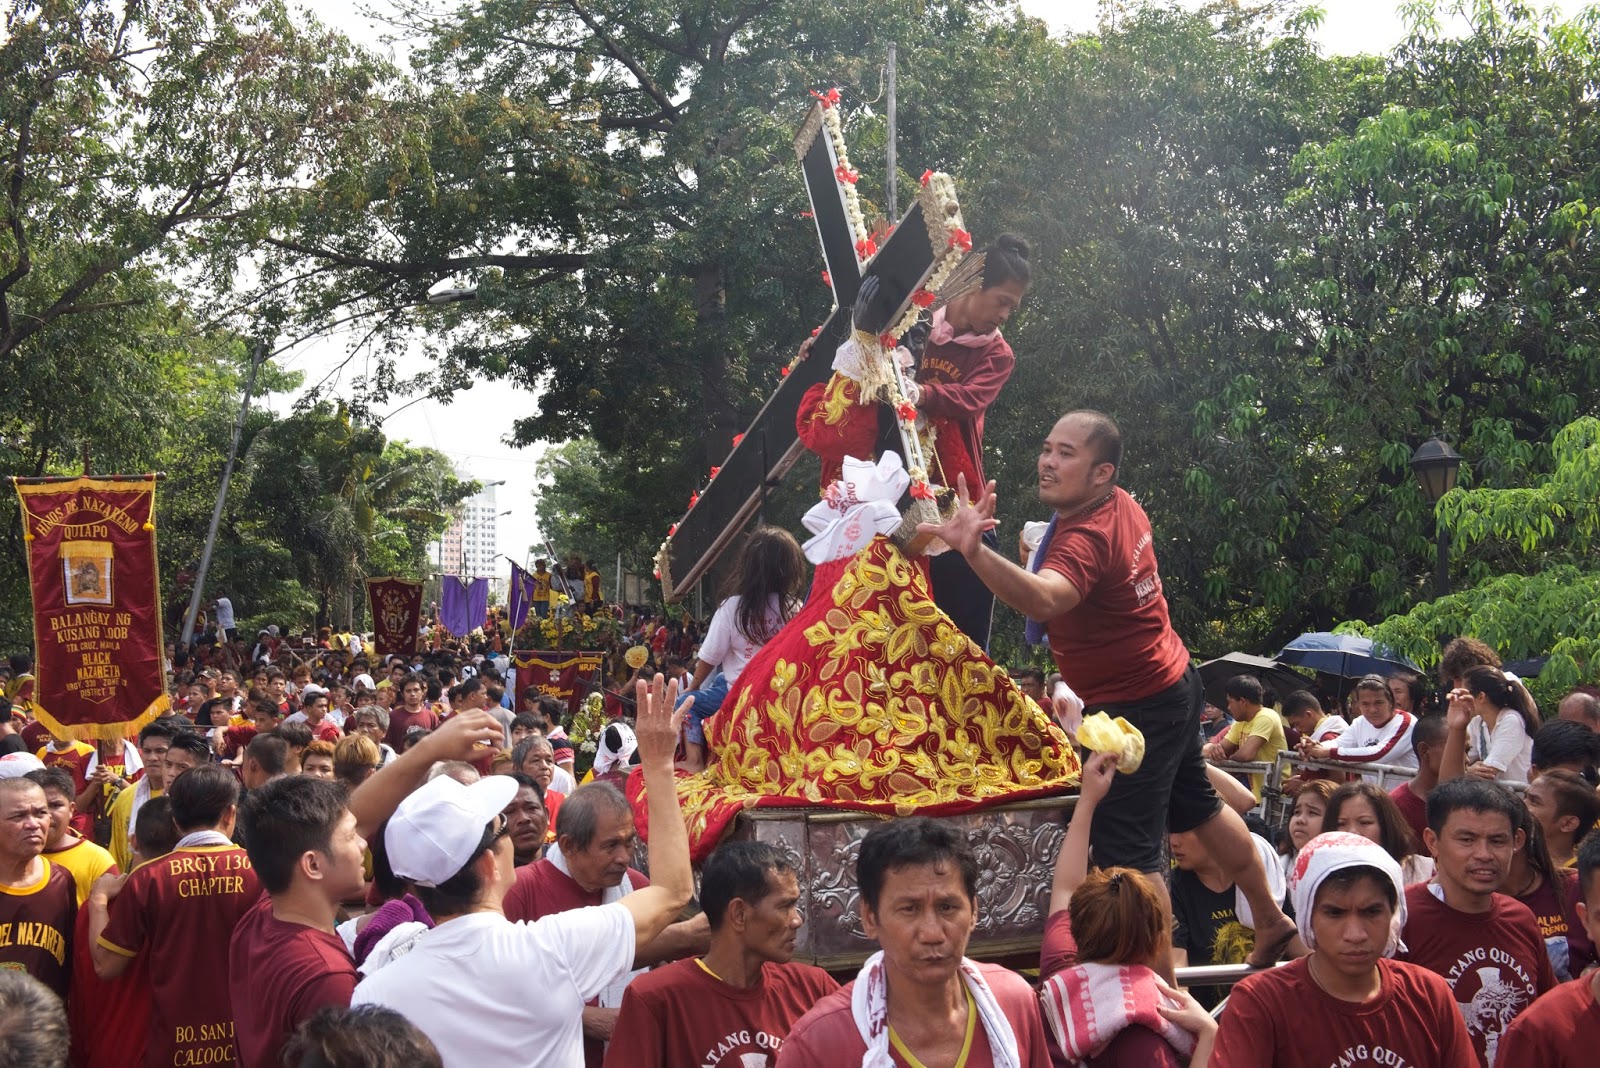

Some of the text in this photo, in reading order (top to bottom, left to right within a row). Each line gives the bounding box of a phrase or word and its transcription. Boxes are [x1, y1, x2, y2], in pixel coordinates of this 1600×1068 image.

[931, 358, 954, 373] BLACK
[35, 496, 139, 537] HIJOS DE NAZARENO
[64, 525, 108, 540] QUIAPO
[50, 611, 132, 631] BALANGAY NG
[57, 626, 128, 643] KUSANG LOOB
[82, 651, 111, 666] BLACK
[76, 665, 121, 681] NAZARETH
[169, 855, 220, 876] BRGY
[178, 875, 245, 898] CHAPTER
[1550, 914, 1562, 924] NA
[1489, 947, 1535, 995] QUIAPO
[175, 1025, 197, 1043] BO.
[200, 1022, 226, 1041] SAN
[174, 1044, 236, 1067] CALOOC
